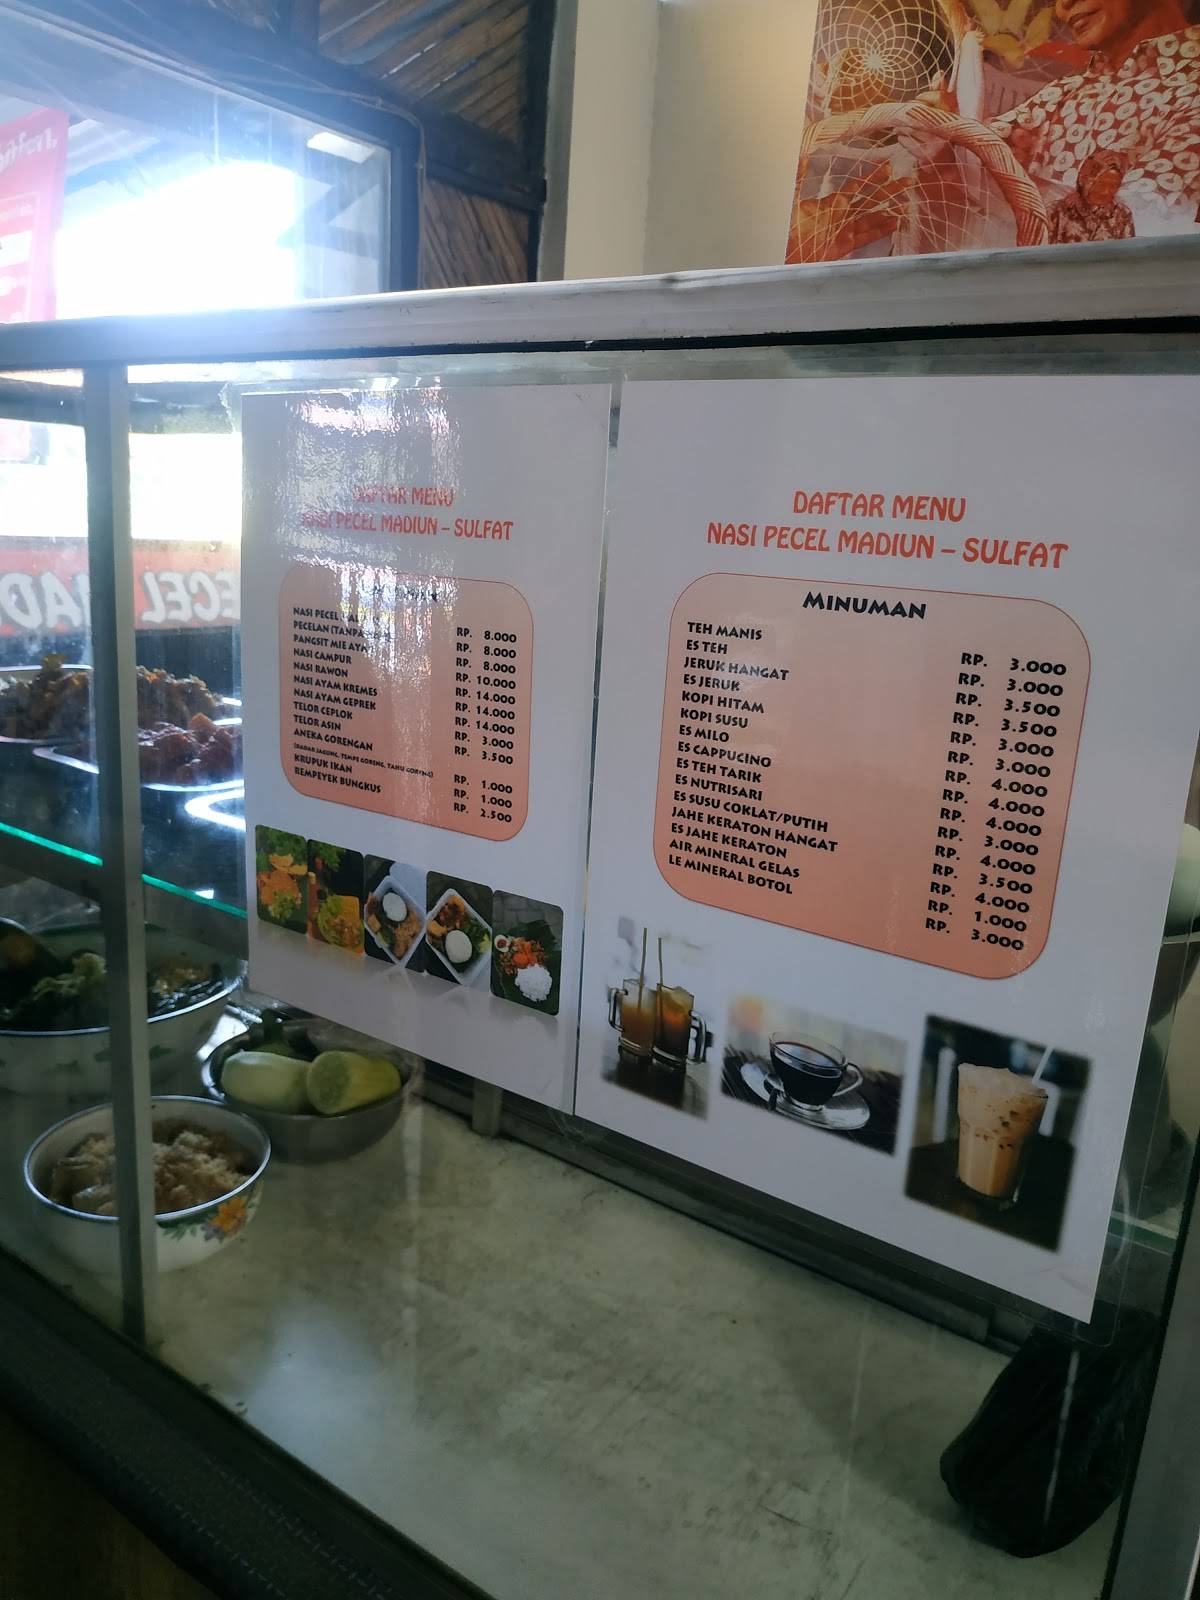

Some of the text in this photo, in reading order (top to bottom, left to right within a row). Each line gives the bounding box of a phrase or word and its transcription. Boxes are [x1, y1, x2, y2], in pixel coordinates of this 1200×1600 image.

[412, 488, 454, 506] MENU
[793, 491, 967, 522] DAFTAR MENU
[336, 512, 376, 531] PECEL
[381, 515, 438, 535] MADIUN
[454, 519, 513, 541] SULFAT
[707, 522, 756, 546] NASI
[763, 526, 829, 552] PECEL
[838, 530, 934, 559] MADIUN
[962, 537, 1069, 569] SULFAT
[293, 608, 312, 616] NASI
[315, 610, 338, 621] PECEL
[457, 628, 472, 638] RP.
[484, 631, 517, 643] 8.000
[803, 591, 927, 619] MINUMAN
[294, 621, 329, 632] PECELAN
[331, 626, 364, 637] (TANPA
[457, 643, 472, 653] RP.
[484, 647, 517, 659] 8.000
[294, 635, 328, 647] PANGSIT
[330, 640, 346, 649] MIE
[456, 659, 471, 668] RP.
[483, 662, 516, 674] 8.000
[687, 622, 1066, 675] TEH MANIS RP. 3.000
[294, 648, 516, 689] NASI CAMPUR RP. 10.000
[294, 662, 516, 705] NASI RAWON RP. 14.000
[684, 657, 1060, 716] JERUK HANGAT RP. 3.500
[686, 640, 1063, 696] ES TEH RP. 3.000
[294, 676, 515, 719] NASI AYAM KREMES RP. 14.000
[294, 689, 515, 735] NASI AYAM GEPREK RP. 14.000
[682, 691, 1054, 757] KOPI HITAM RP. 3.000
[683, 674, 1057, 737] ES JERUK RP. 3.500
[294, 702, 514, 749] TELOR CEPLOK RP. 3.000
[294, 715, 513, 764] TELOR ASIN RP. 3.500
[294, 728, 373, 751] ANEKA GORENGAN
[681, 708, 1051, 777] KOPI SUSU RP. 3.000
[294, 754, 512, 808] KRUPUK IKAN RP. 1.000
[387, 763, 404, 772] TAHU
[454, 775, 469, 785] RP.
[481, 780, 513, 794] 1.000
[678, 742, 1044, 816] ES CAPPUCINO RP. 4.000
[679, 725, 1048, 797] ES MILO RP. 4.000
[295, 767, 512, 823] REMPEYEK BUNGKUS RP. 2.500
[675, 774, 1038, 856] ES NUTRISARI RP. 3.000
[676, 758, 1042, 836] ES TEH TARIK RP. 4.000
[672, 807, 1032, 894] JAHE KERATON HANGAT RP. 3.500
[674, 791, 1036, 874] ES SUSU COKLAT/PUTIH RP. 4.000
[669, 839, 1027, 931] AIR MINERAL GELAS RP. 1.000
[671, 823, 1029, 912] ES JAHE KERATON RP. 4.000
[669, 855, 1024, 950] LE MINERAL BOTOL RP. 3.000
